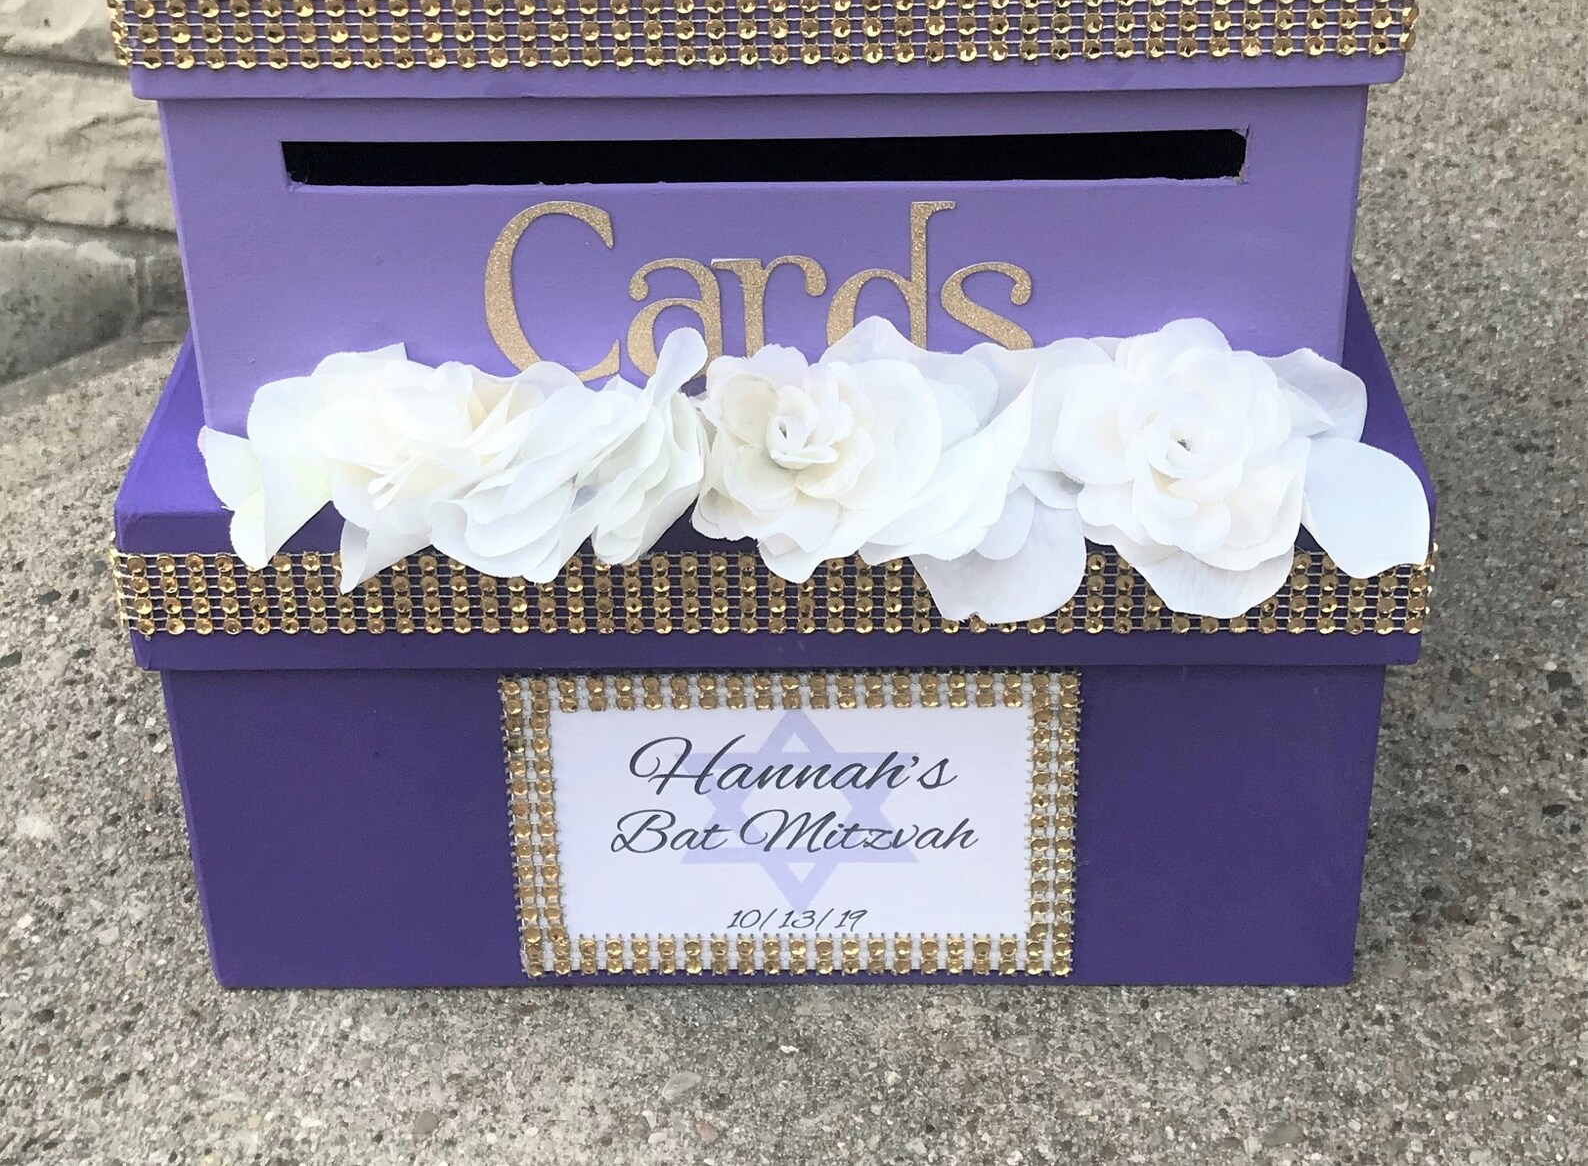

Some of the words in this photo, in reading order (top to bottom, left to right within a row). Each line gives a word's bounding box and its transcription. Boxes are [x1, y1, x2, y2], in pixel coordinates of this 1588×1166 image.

[484, 200, 1034, 381] Cards
[629, 734, 958, 796] Hannah's
[610, 809, 734, 854] Bat
[739, 809, 979, 854] Mitzvah
